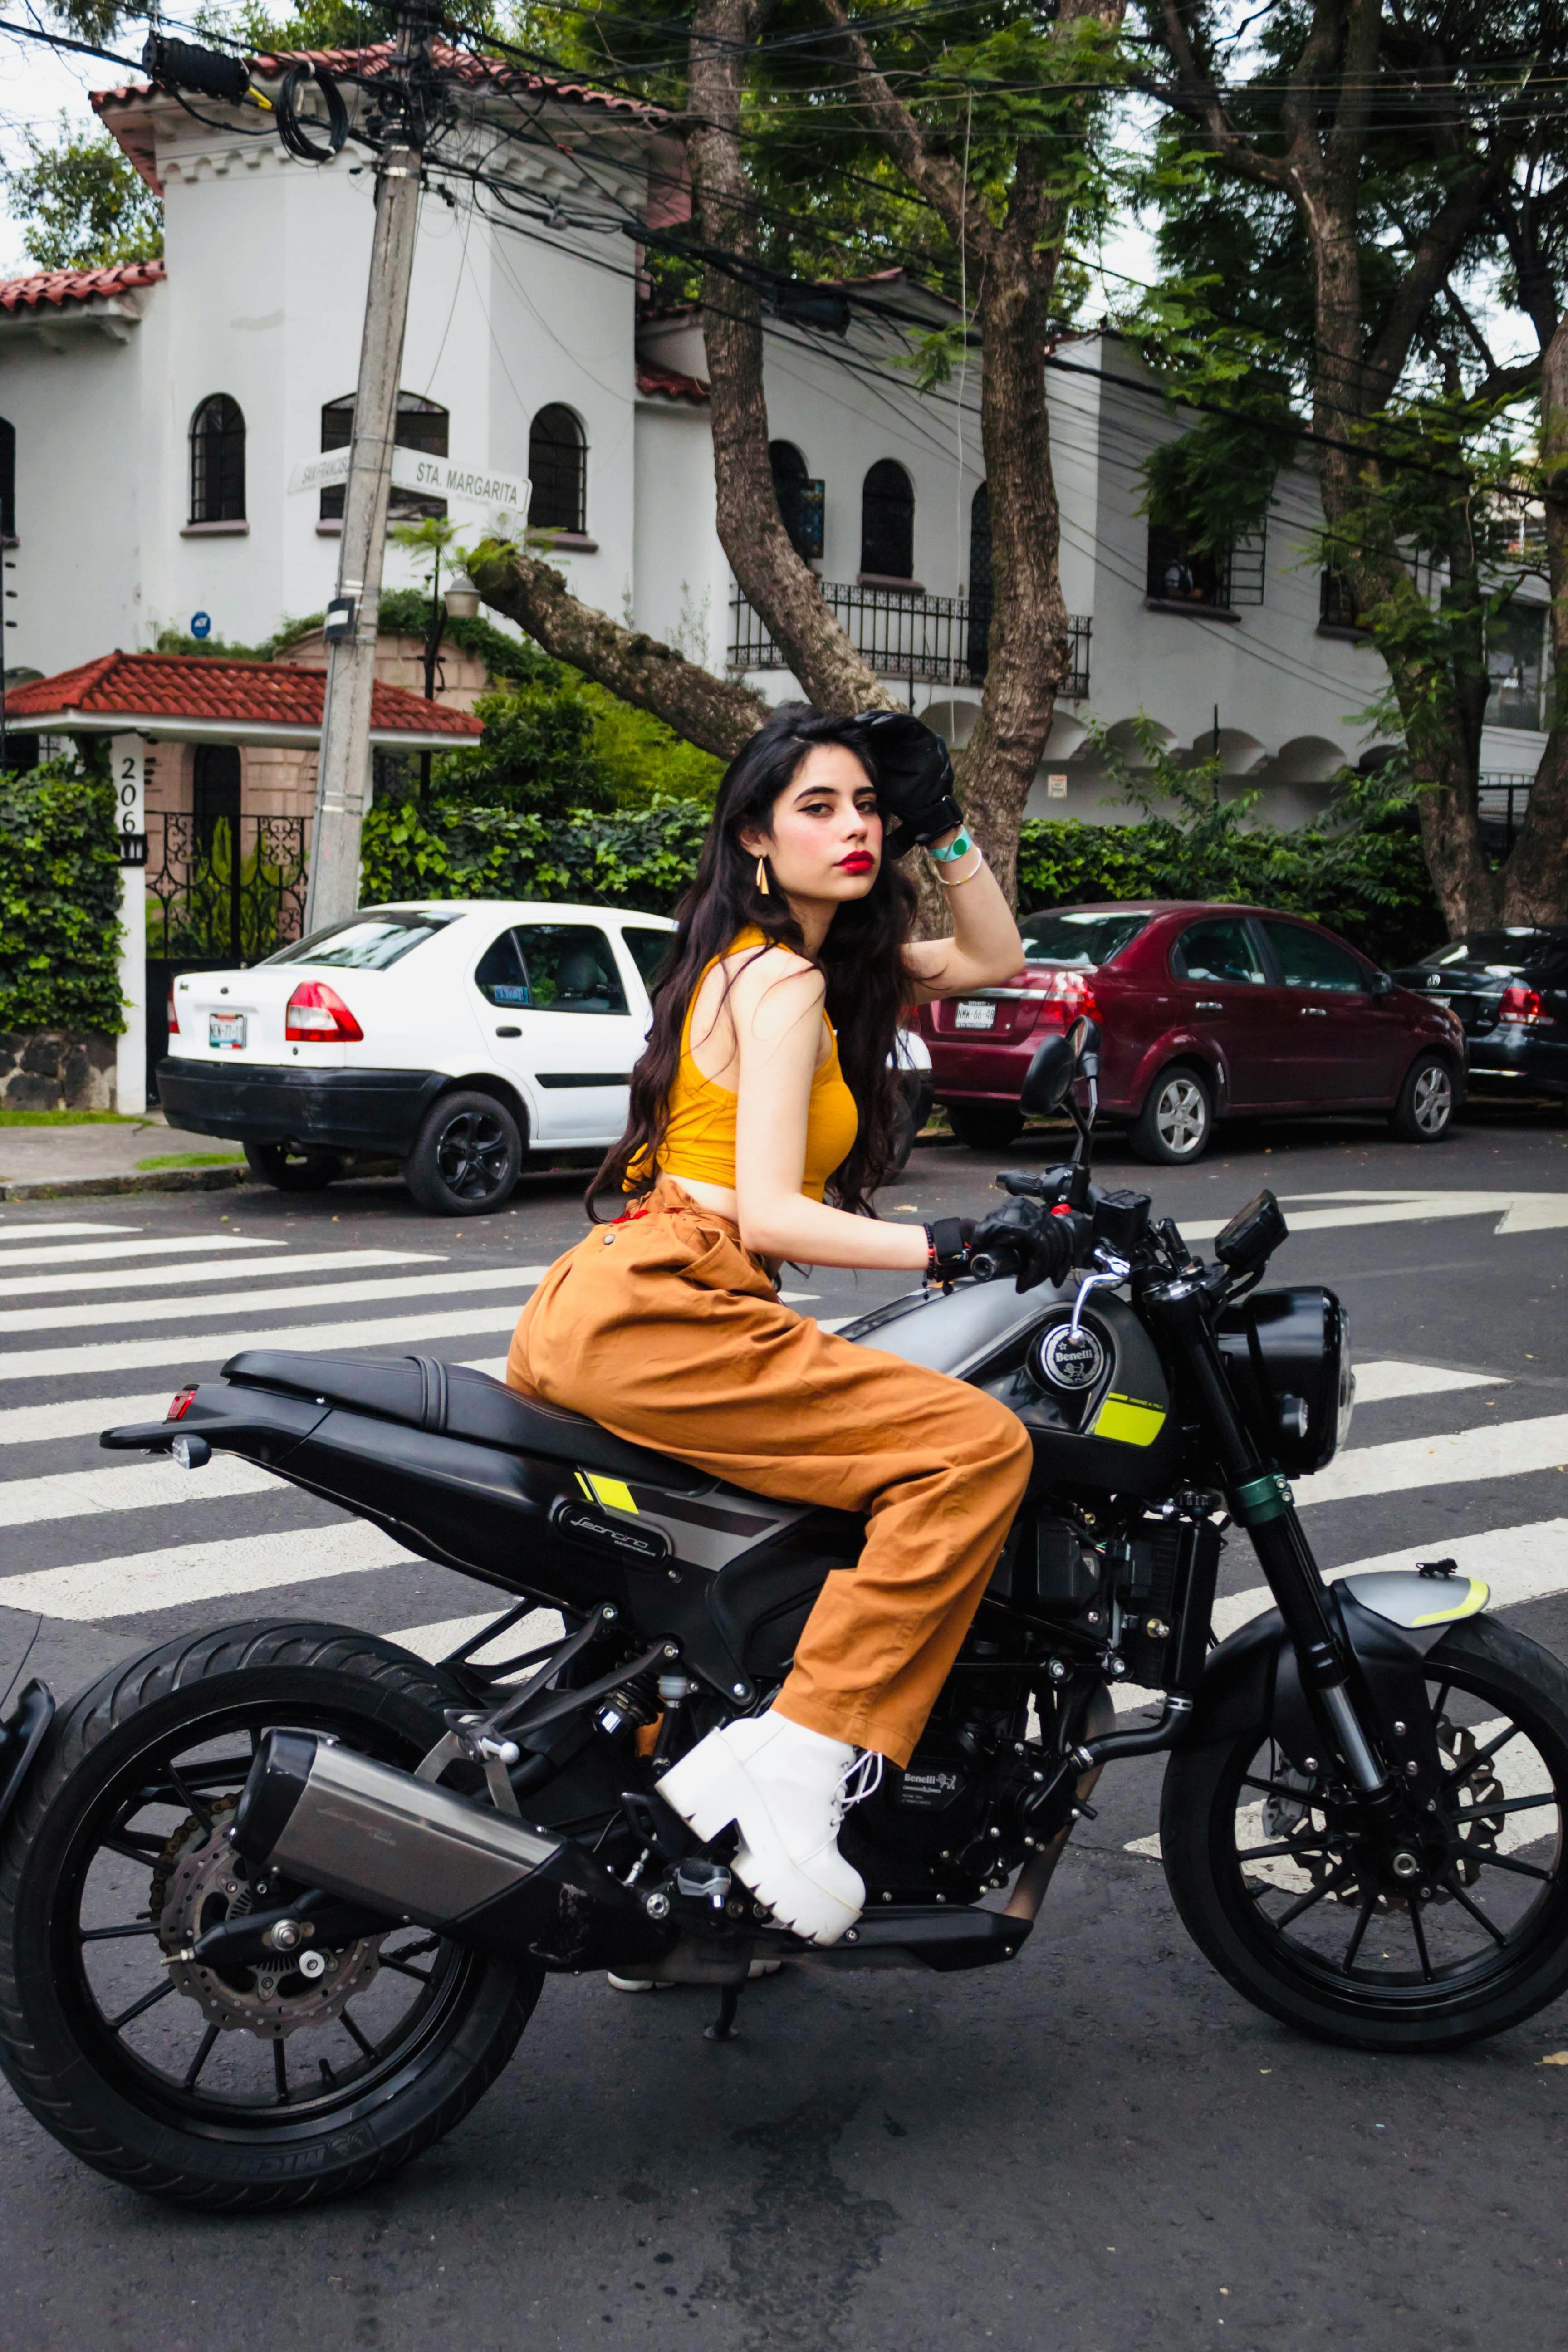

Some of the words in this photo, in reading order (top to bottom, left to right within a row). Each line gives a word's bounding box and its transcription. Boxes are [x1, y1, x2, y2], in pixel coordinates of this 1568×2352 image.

[416, 462, 442, 487] STA.
[446, 470, 517, 505] MARGARITA
[121, 757, 136, 834] 206
[1055, 1349, 1093, 1362] Benelli
[904, 1773, 936, 1784] Benelli
